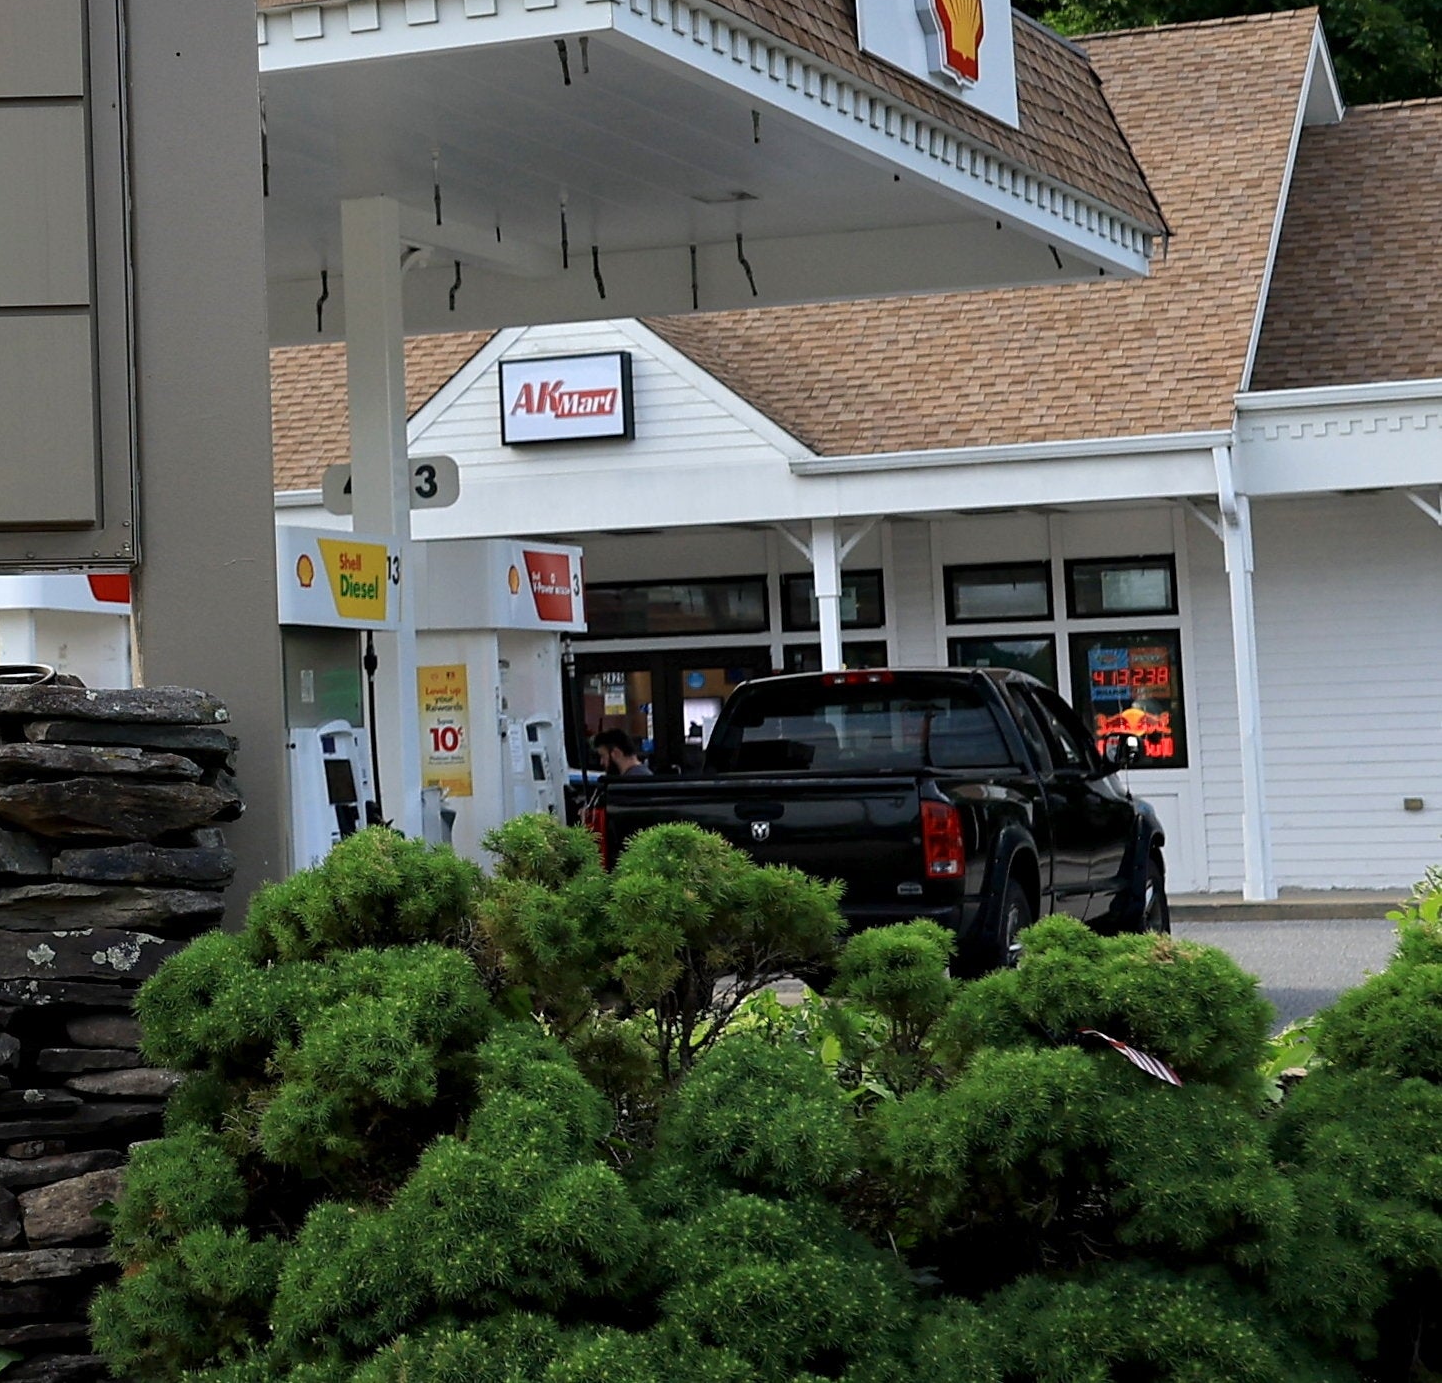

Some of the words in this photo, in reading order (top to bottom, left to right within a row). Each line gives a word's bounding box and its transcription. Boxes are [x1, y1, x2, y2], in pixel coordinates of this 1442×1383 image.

[414, 464, 438, 498] 3
[339, 552, 362, 571] Shell
[386, 555, 400, 585] 13
[340, 574, 379, 600] Diesel
[573, 573, 580, 596] 3
